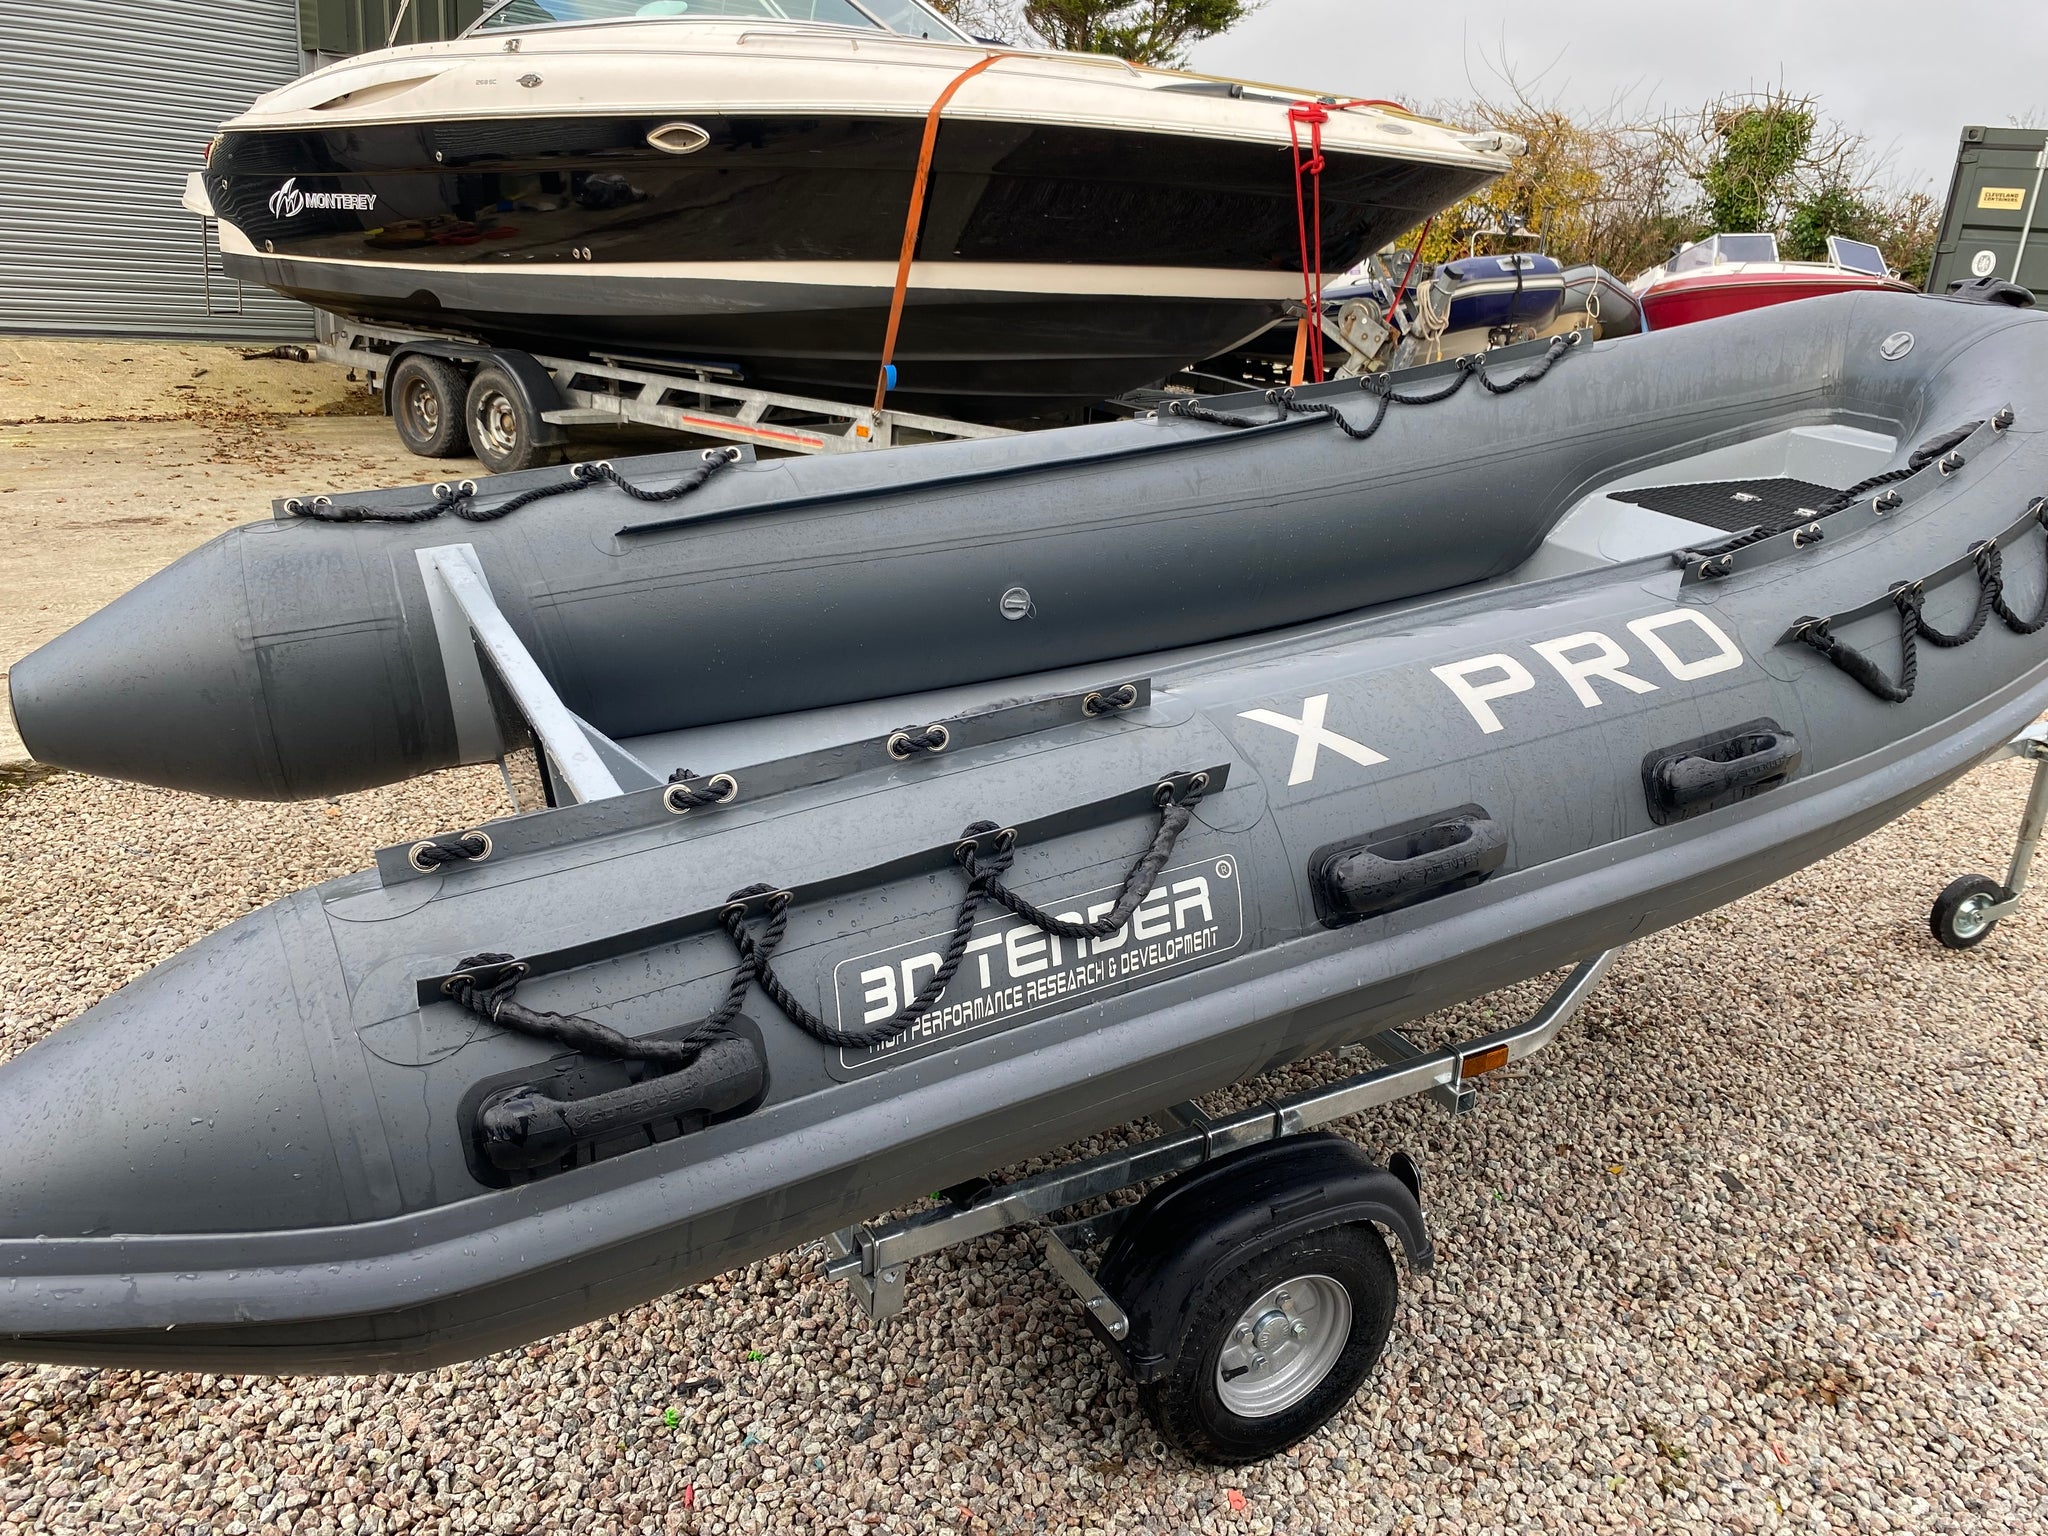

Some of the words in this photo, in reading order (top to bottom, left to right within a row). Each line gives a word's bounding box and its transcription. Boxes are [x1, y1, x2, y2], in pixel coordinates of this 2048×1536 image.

[304, 192, 377, 211] MONTEREY
[1236, 693, 1390, 786] X
[1430, 608, 1744, 734] PRO
[911, 985, 1023, 1040] PERFORMANCE
[1026, 960, 1105, 1004] RESEARCH
[1108, 957, 1117, 978] &
[1120, 926, 1219, 973] DEVELOPMENT
[963, 876, 1214, 989] TENDER
